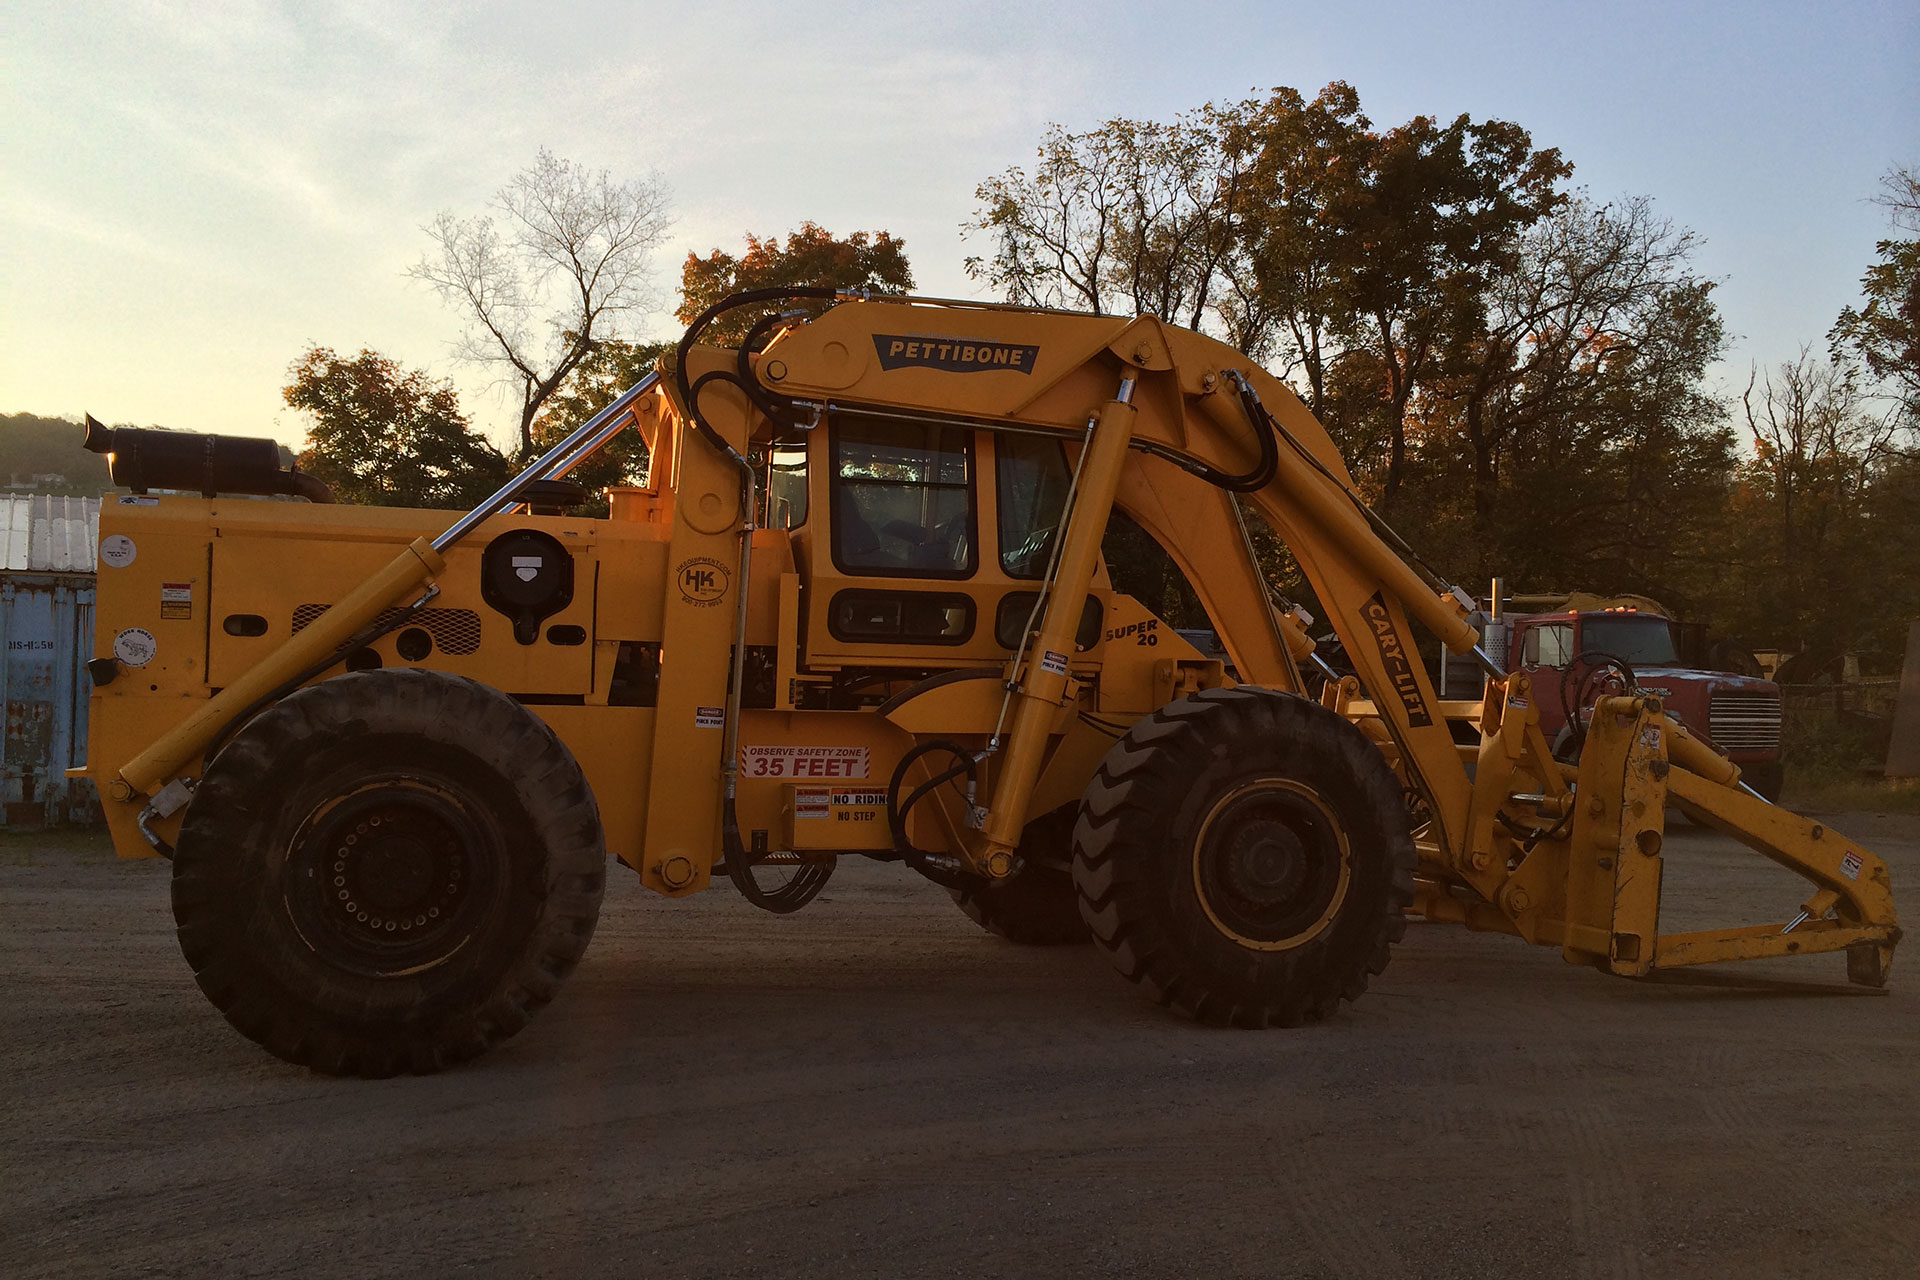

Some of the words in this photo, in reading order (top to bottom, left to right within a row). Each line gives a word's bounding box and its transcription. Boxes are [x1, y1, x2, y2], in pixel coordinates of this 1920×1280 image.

[889, 340, 1024, 366] PETTIBONE
[685, 569, 715, 592] HK
[1104, 619, 1159, 642] SUPER
[1136, 633, 1159, 647] 20
[1368, 603, 1427, 719] CARY-LIFT
[750, 747, 795, 756] OBSERVE
[797, 748, 835, 757] SAFETY
[835, 748, 862, 757] ZONE
[753, 757, 784, 776] 35
[792, 758, 858, 776] FEET
[833, 795, 849, 804] NO
[855, 795, 889, 804] RIDIN
[837, 811, 850, 821] NO
[853, 811, 876, 821] STEP
